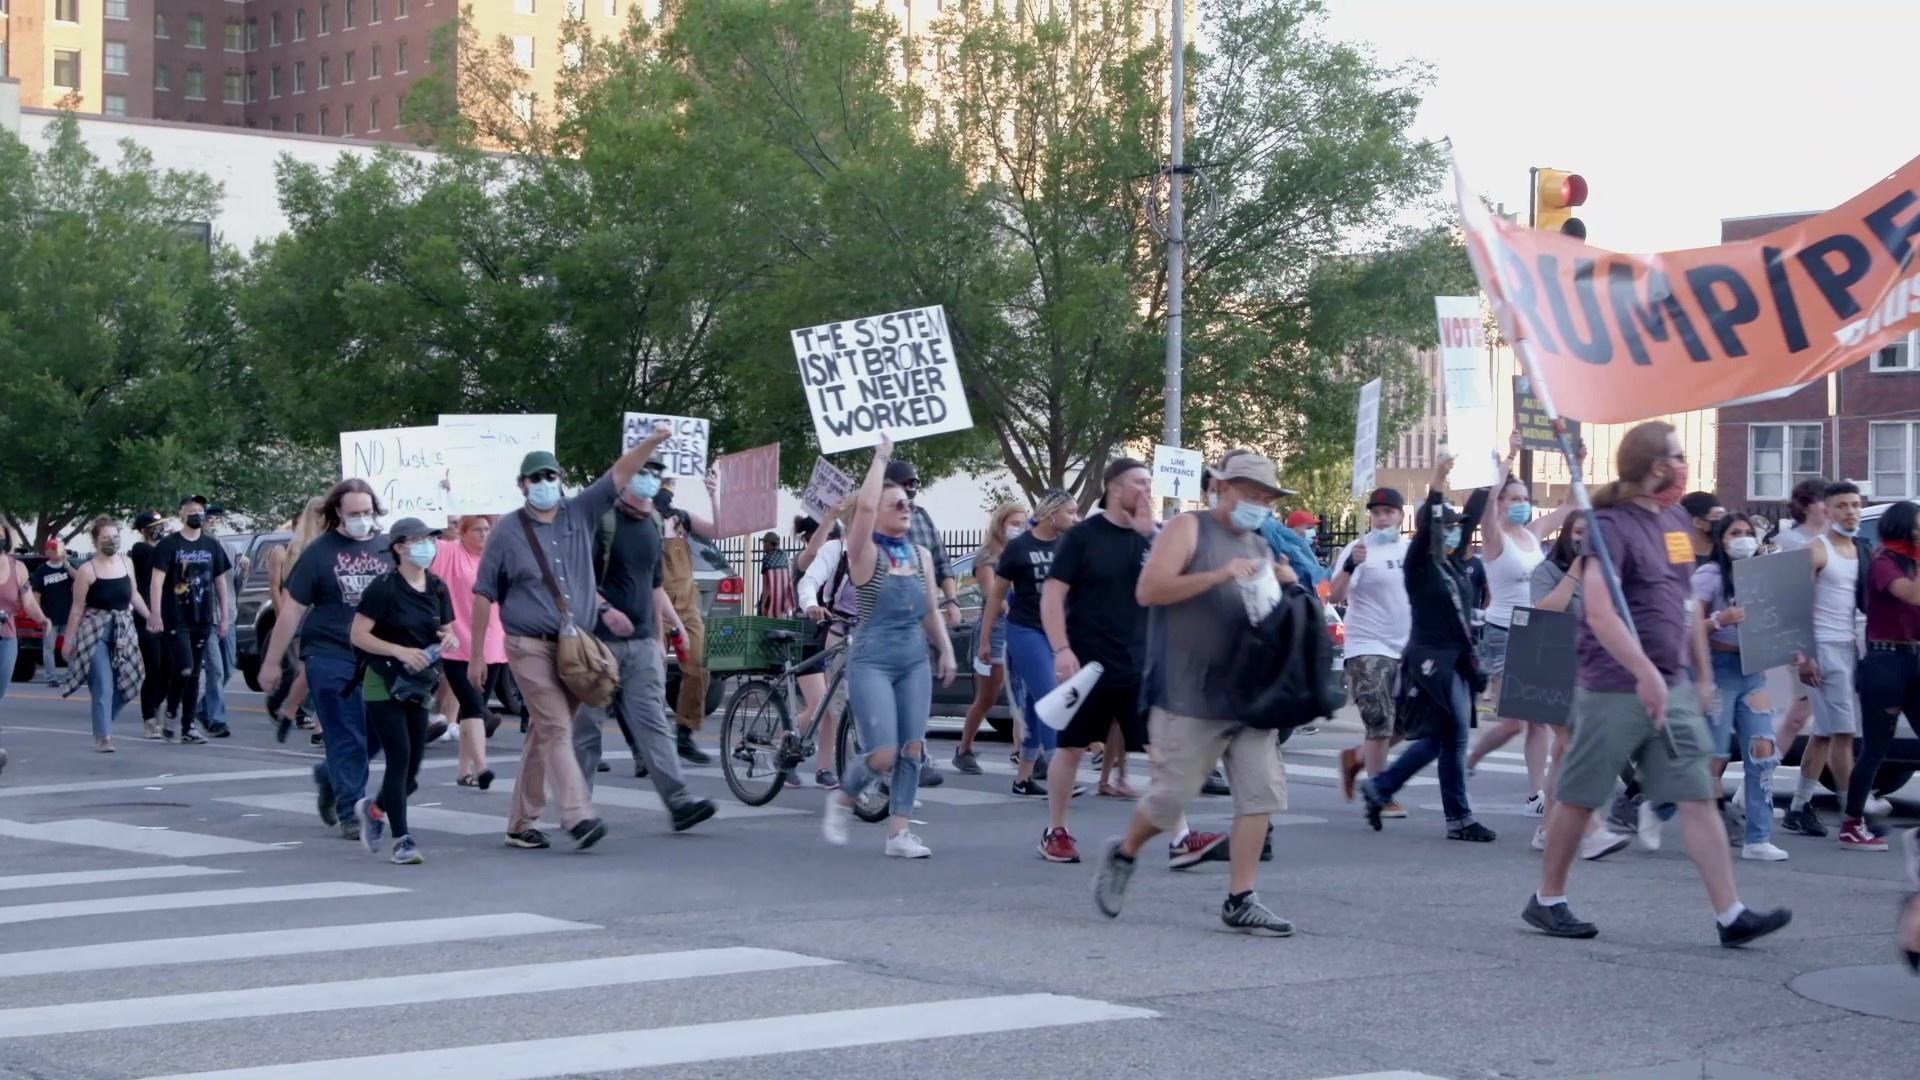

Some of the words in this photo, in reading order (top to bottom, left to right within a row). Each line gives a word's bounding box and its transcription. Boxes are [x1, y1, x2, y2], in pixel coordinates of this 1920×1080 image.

[796, 323, 847, 351] THE
[854, 307, 947, 348] SYSTEM
[800, 349, 858, 386] ISN'T
[862, 338, 948, 377] BROKE
[818, 384, 846, 412] IT
[857, 366, 946, 403] NEVER
[823, 394, 947, 437] WORKED
[1160, 465, 1195, 477] ENTRANCE
[1171, 458, 1185, 467] LINE
